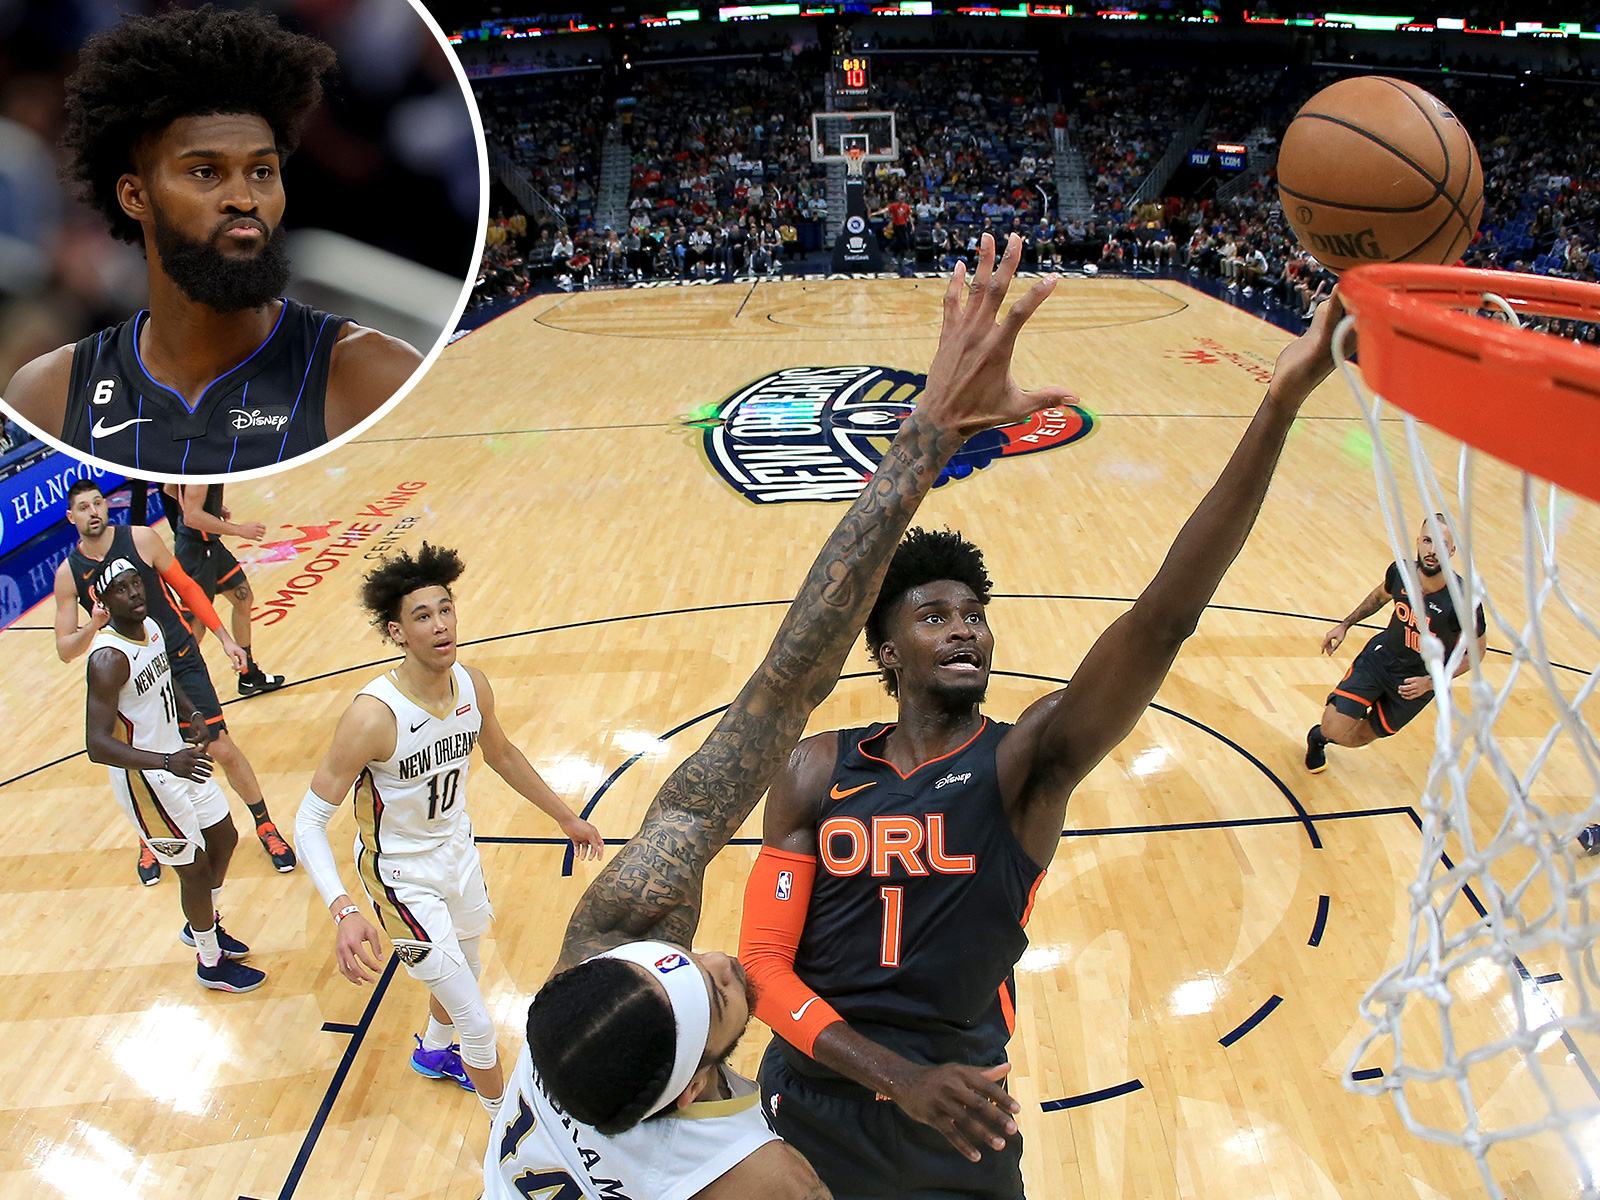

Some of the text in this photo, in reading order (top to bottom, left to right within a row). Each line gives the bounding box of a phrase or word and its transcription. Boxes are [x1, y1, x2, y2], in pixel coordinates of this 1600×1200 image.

[843, 58, 867, 71] 6:31
[846, 69, 865, 87] 10
[93, 379, 115, 405] 6
[728, 366, 872, 501] NEW ORLEANS
[364, 516, 421, 560] CENTER
[251, 522, 383, 626] SMOOTHIE
[134, 664, 156, 697] NEW
[160, 680, 176, 724] 11
[399, 745, 432, 780] NEW
[427, 768, 461, 821] 10
[818, 813, 976, 877] ORL
[879, 886, 904, 968] 1
